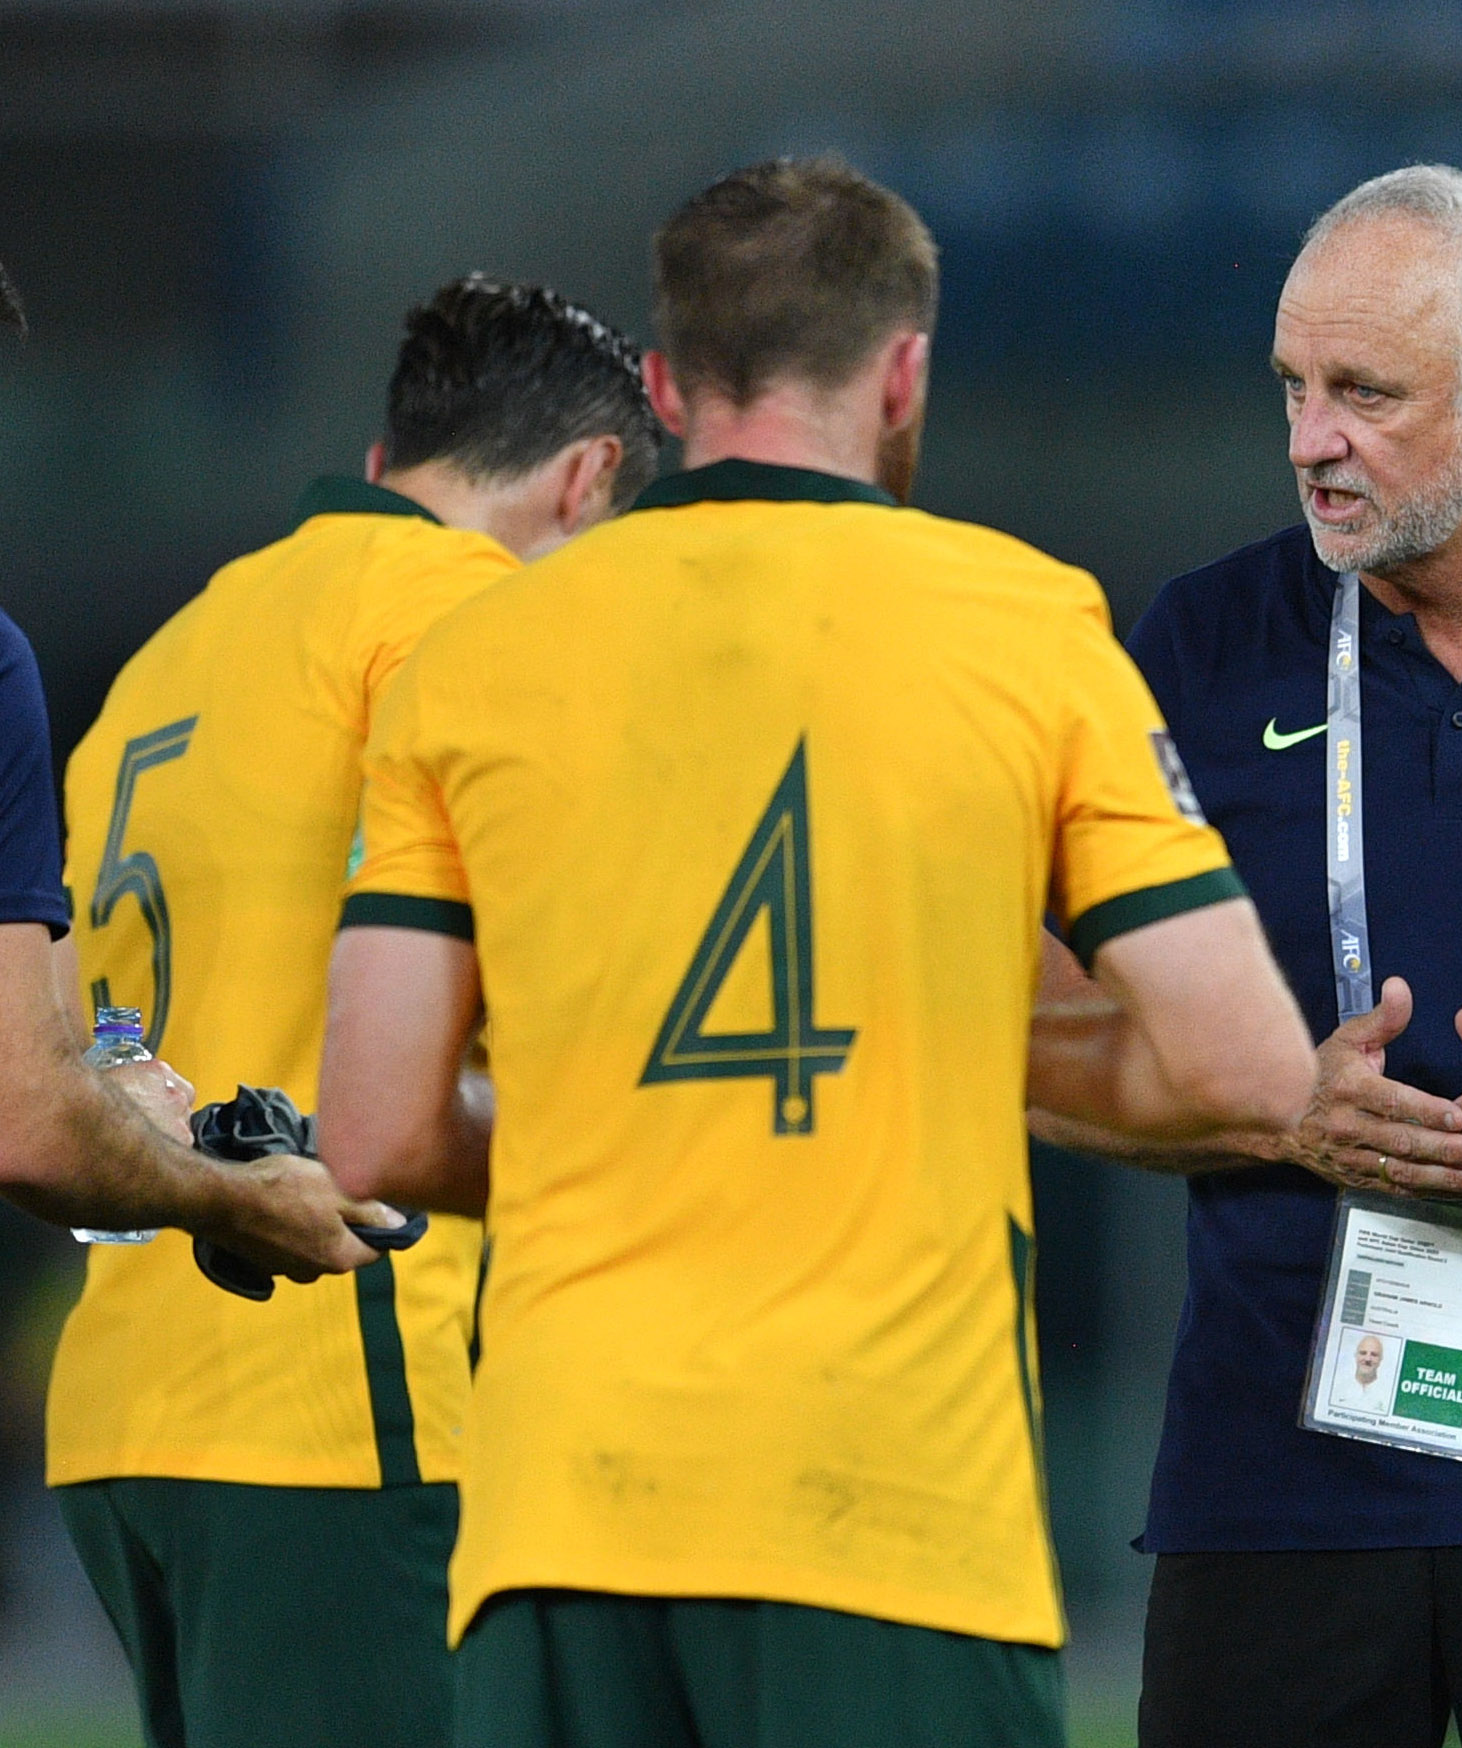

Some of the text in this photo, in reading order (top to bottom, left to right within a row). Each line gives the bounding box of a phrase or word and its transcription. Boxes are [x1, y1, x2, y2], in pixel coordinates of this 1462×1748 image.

[1336, 629, 1352, 670] AFC
[1337, 740, 1353, 862] the-AFC.com
[90, 714, 199, 1058] 5
[638, 731, 857, 1137] 4
[1340, 929, 1361, 972] AFC
[1417, 1367, 1456, 1386] TEAM
[1328, 1409, 1457, 1440] Participating Member Association
